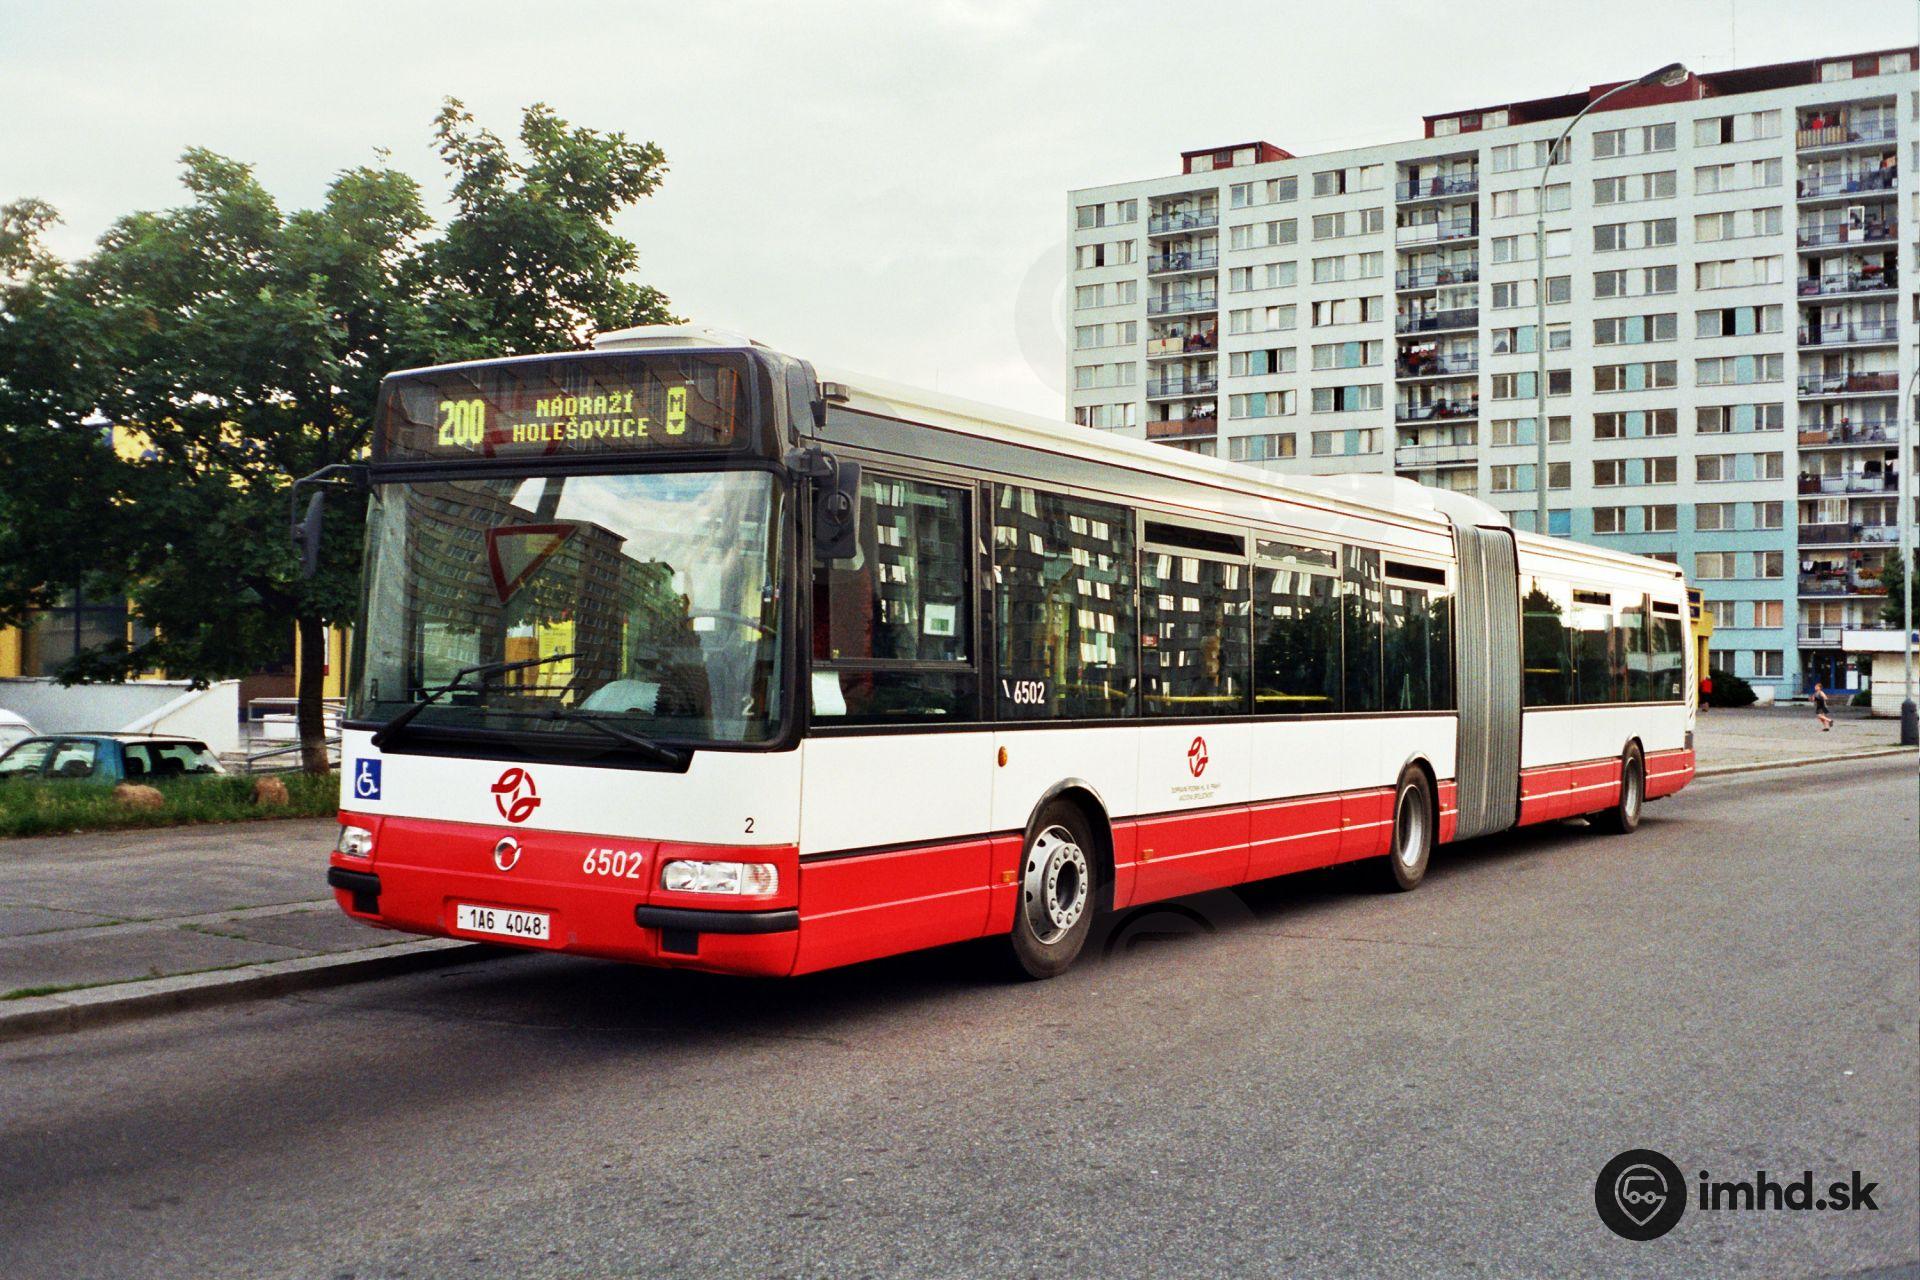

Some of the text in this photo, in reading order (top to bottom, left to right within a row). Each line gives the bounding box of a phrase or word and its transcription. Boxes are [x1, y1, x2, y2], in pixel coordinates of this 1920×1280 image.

[439, 399, 485, 446] 200
[512, 416, 650, 442] HOLEŠOVICE
[1014, 680, 1046, 705] 6502
[742, 698, 755, 717] 2
[744, 817, 755, 835] 2
[582, 848, 643, 879] 6502
[469, 908, 541, 936] 1A6 4048
